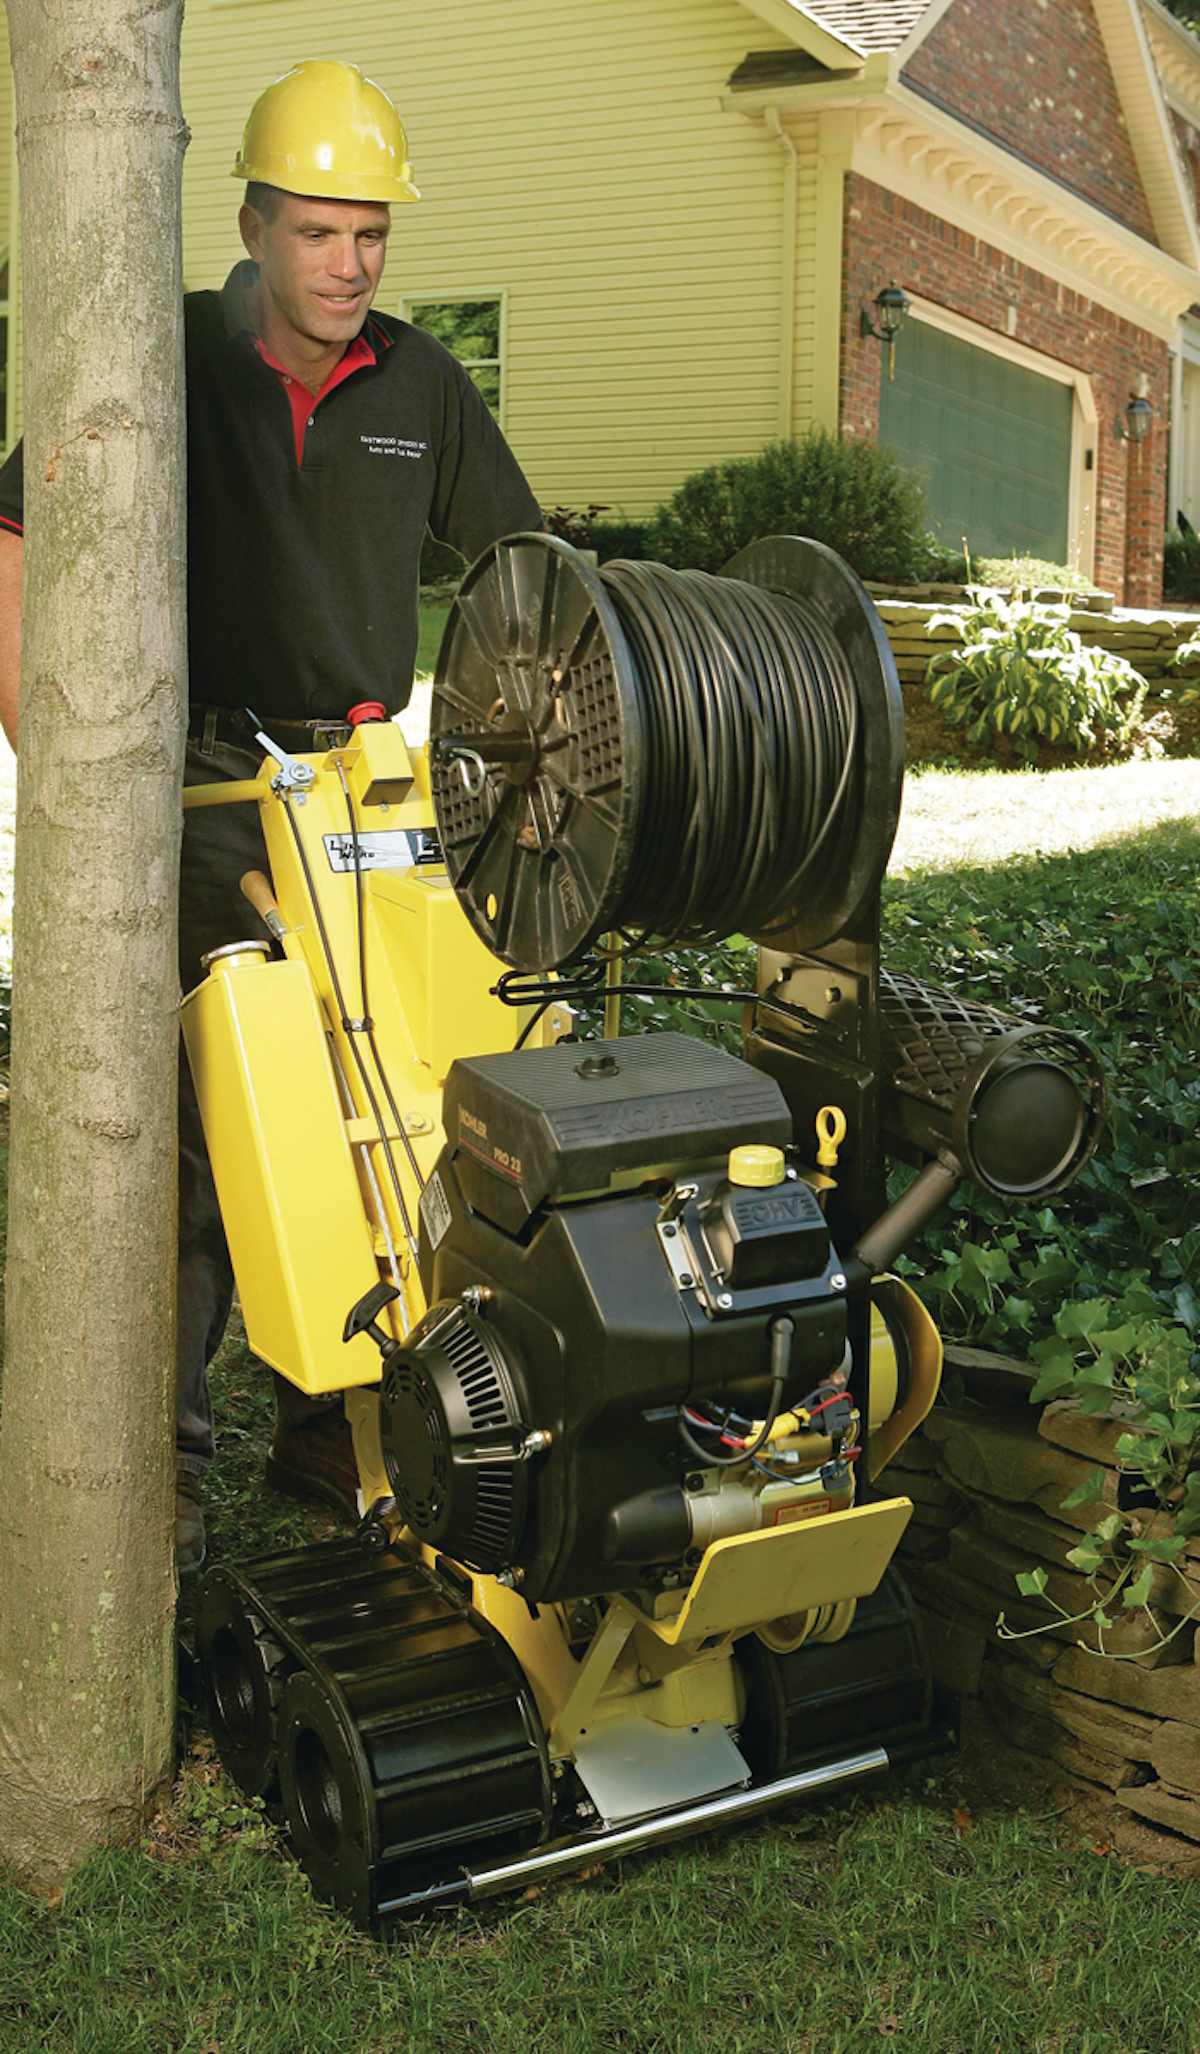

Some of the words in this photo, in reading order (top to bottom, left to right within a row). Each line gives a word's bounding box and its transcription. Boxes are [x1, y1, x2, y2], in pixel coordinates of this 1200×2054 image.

[459, 1103, 488, 1139] KOHLER
[603, 1095, 730, 1136] KOHLER
[494, 1146, 509, 1167] PRO
